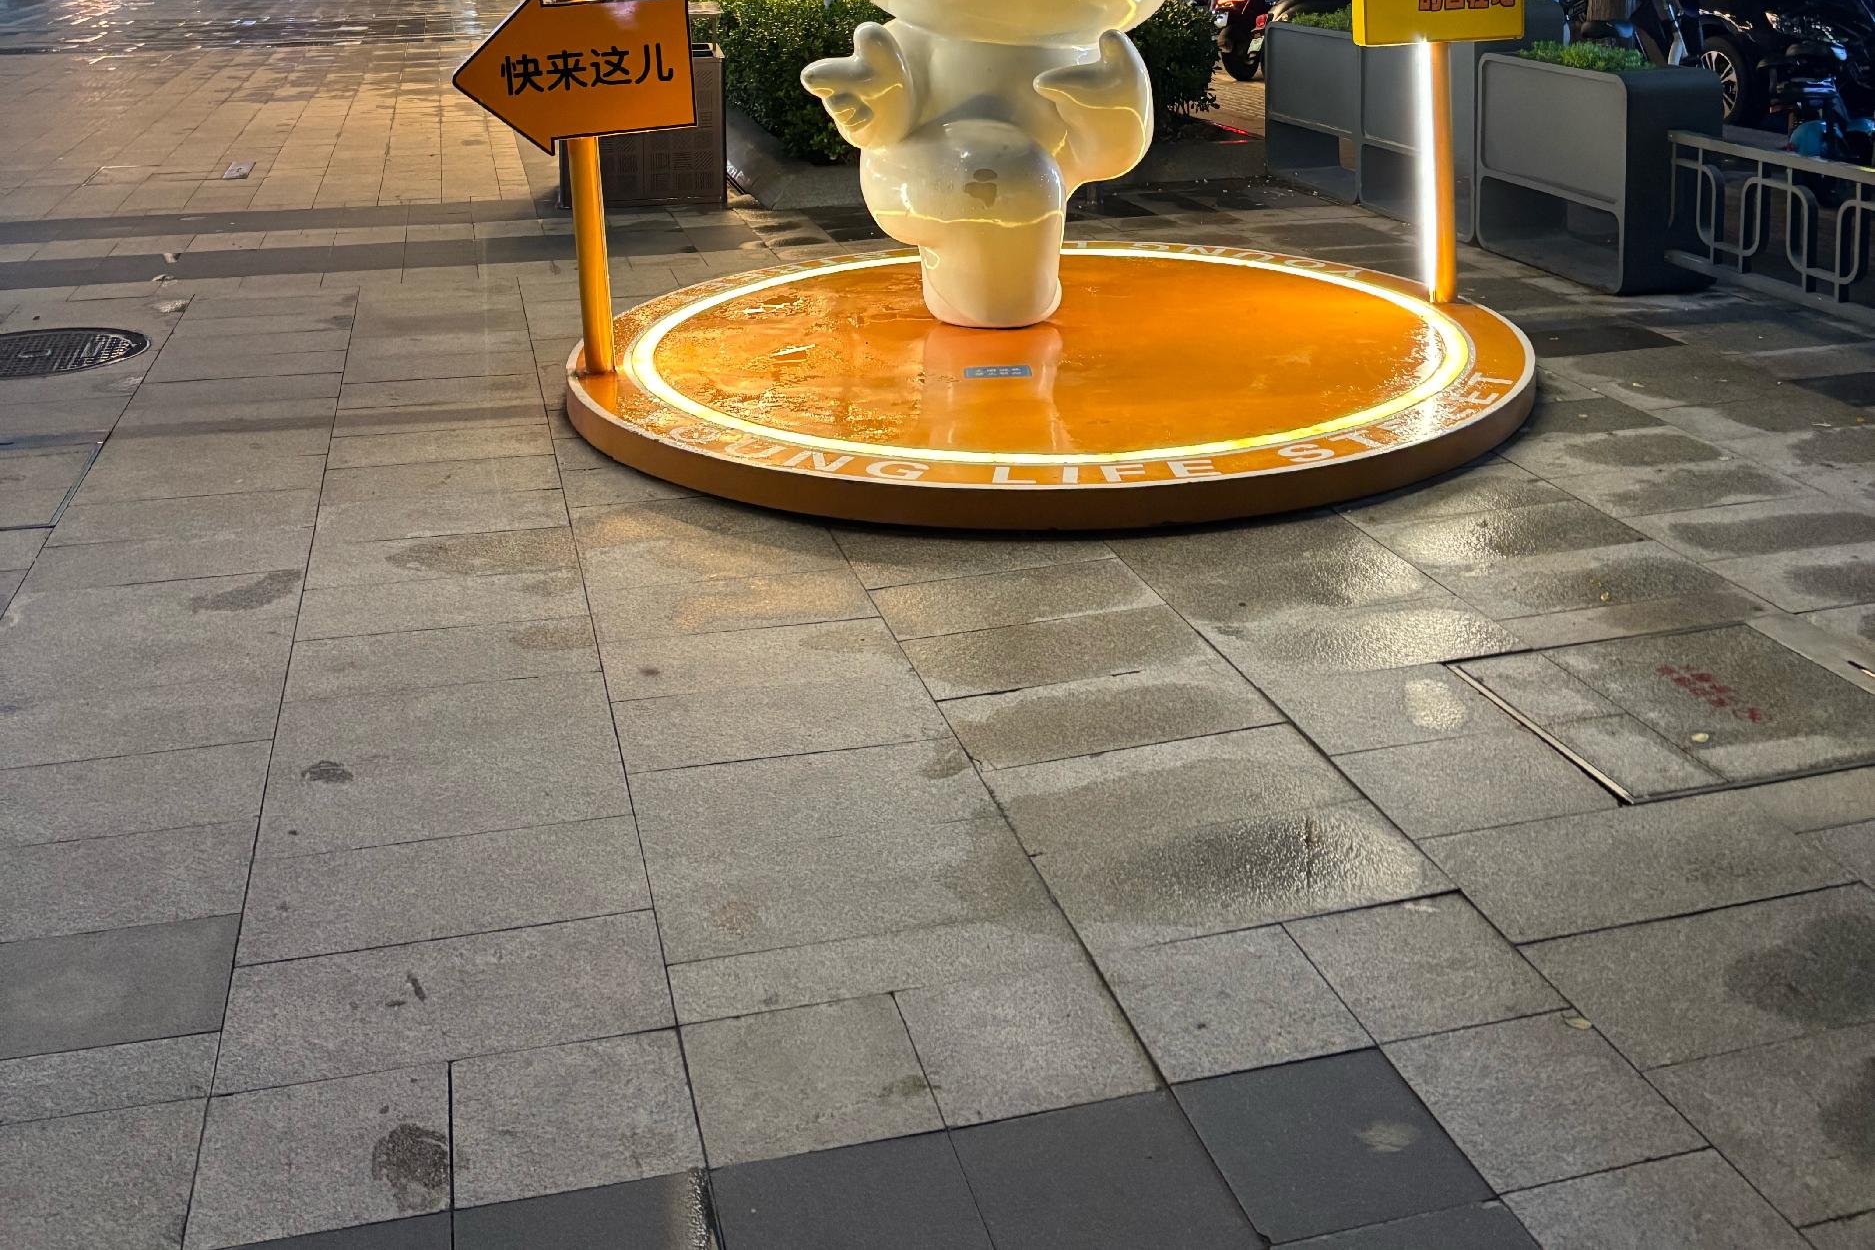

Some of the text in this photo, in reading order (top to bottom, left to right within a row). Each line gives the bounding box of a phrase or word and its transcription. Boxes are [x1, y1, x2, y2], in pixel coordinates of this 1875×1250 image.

[500, 42, 674, 96] 快来这儿
[643, 407, 930, 481] OUNG
[991, 458, 1223, 485] LIFE
